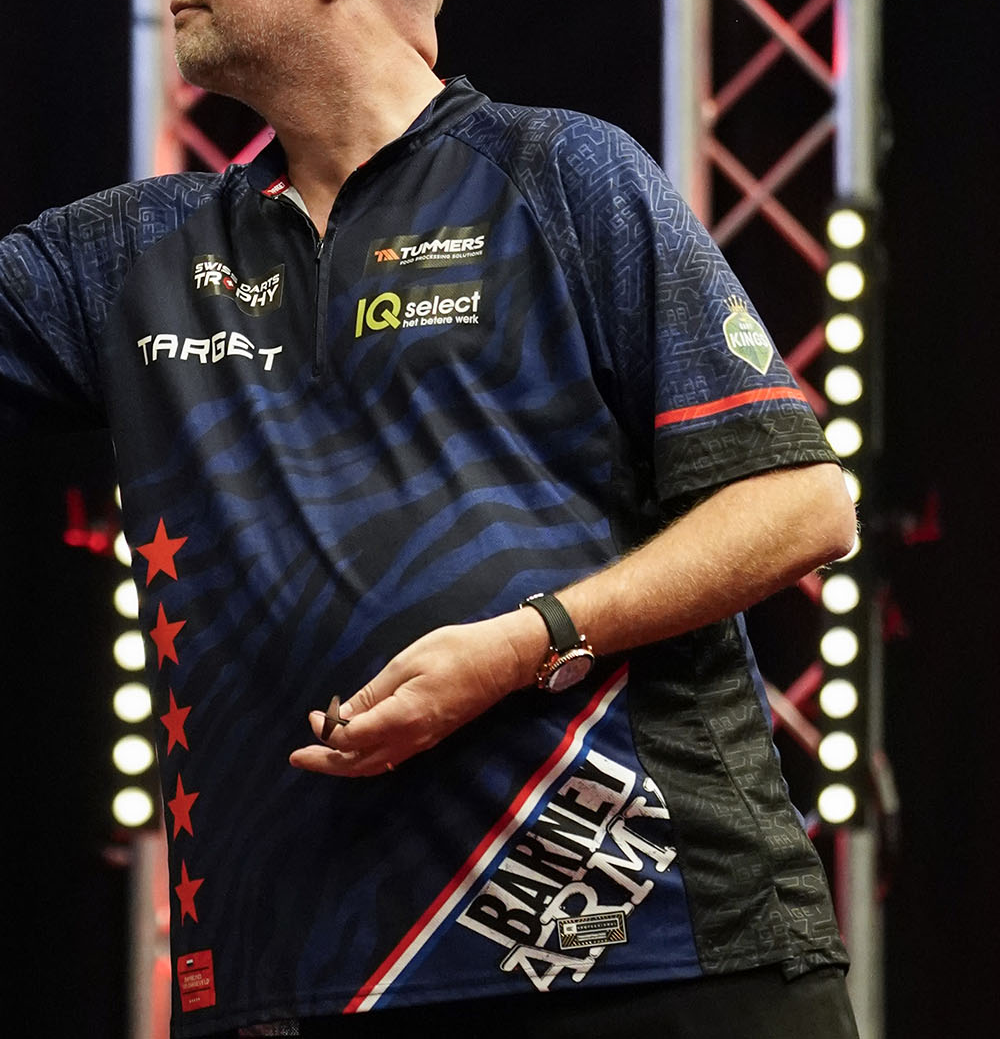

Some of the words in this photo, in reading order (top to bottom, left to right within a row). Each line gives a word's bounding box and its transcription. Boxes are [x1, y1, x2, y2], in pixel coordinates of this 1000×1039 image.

[400, 235, 485, 260] TUMMERS
[452, 250, 483, 260] SOLUTIONS
[240, 273, 280, 294] DARTS
[355, 292, 401, 338] IQ
[404, 291, 481, 318] select
[402, 318, 418, 328] het
[420, 316, 453, 327] betere
[455, 314, 479, 324] werk
[137, 330, 283, 372] TARGET
[729, 331, 769, 348] KINGS
[462, 757, 632, 947] BARNEY
[500, 777, 677, 992] ARMY
